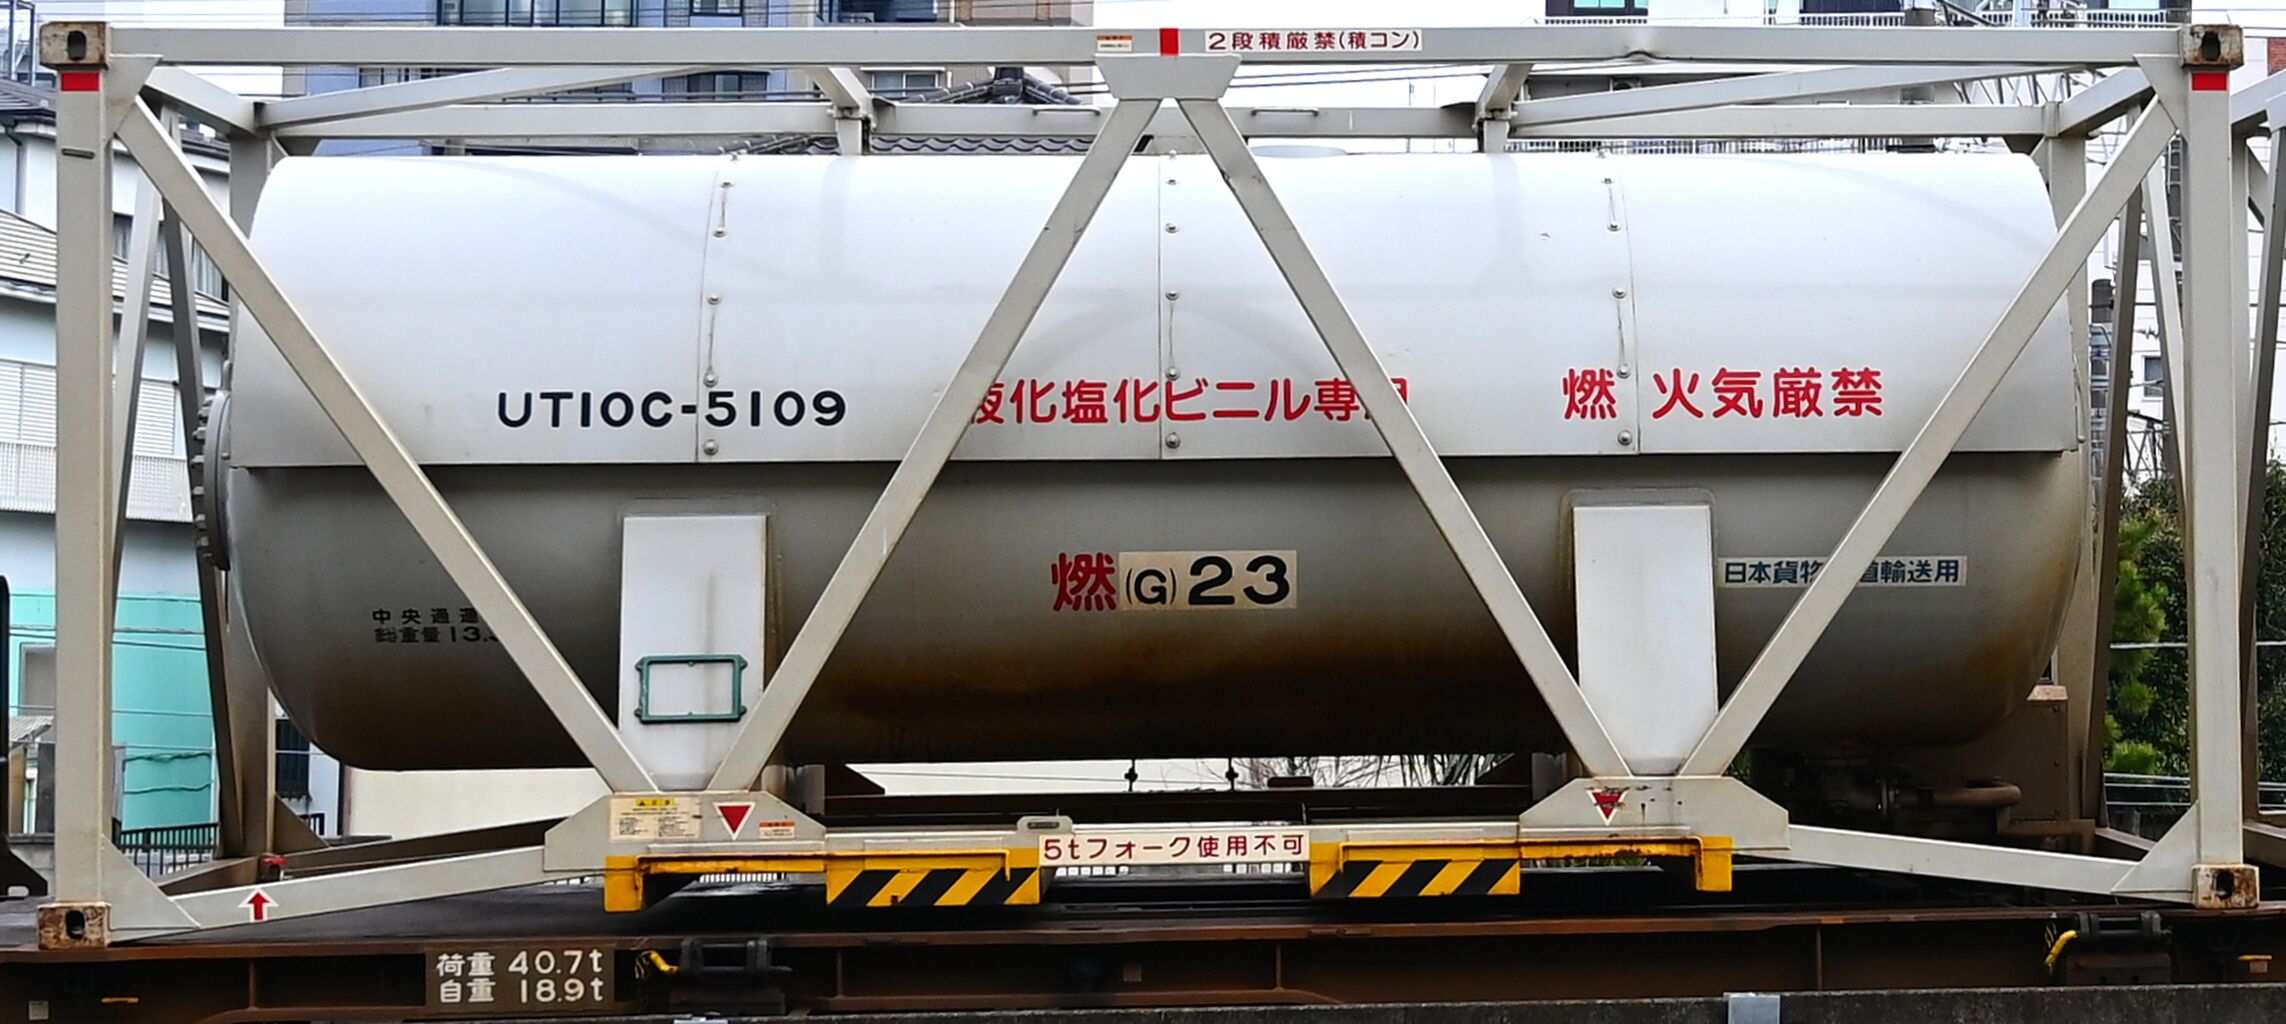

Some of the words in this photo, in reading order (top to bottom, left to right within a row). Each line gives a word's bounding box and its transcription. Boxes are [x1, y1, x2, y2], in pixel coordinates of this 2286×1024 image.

[498, 390, 846, 428] UT10C-5109
[971, 377, 1408, 424] 液化塩化ビニル専
[1563, 368, 1617, 419] 燃
[1651, 368, 1883, 419] 火気厳禁
[1043, 834, 1305, 860] 5tフォーク使用不可
[436, 952, 496, 977] 荷重
[440, 978, 496, 1003] 自重
